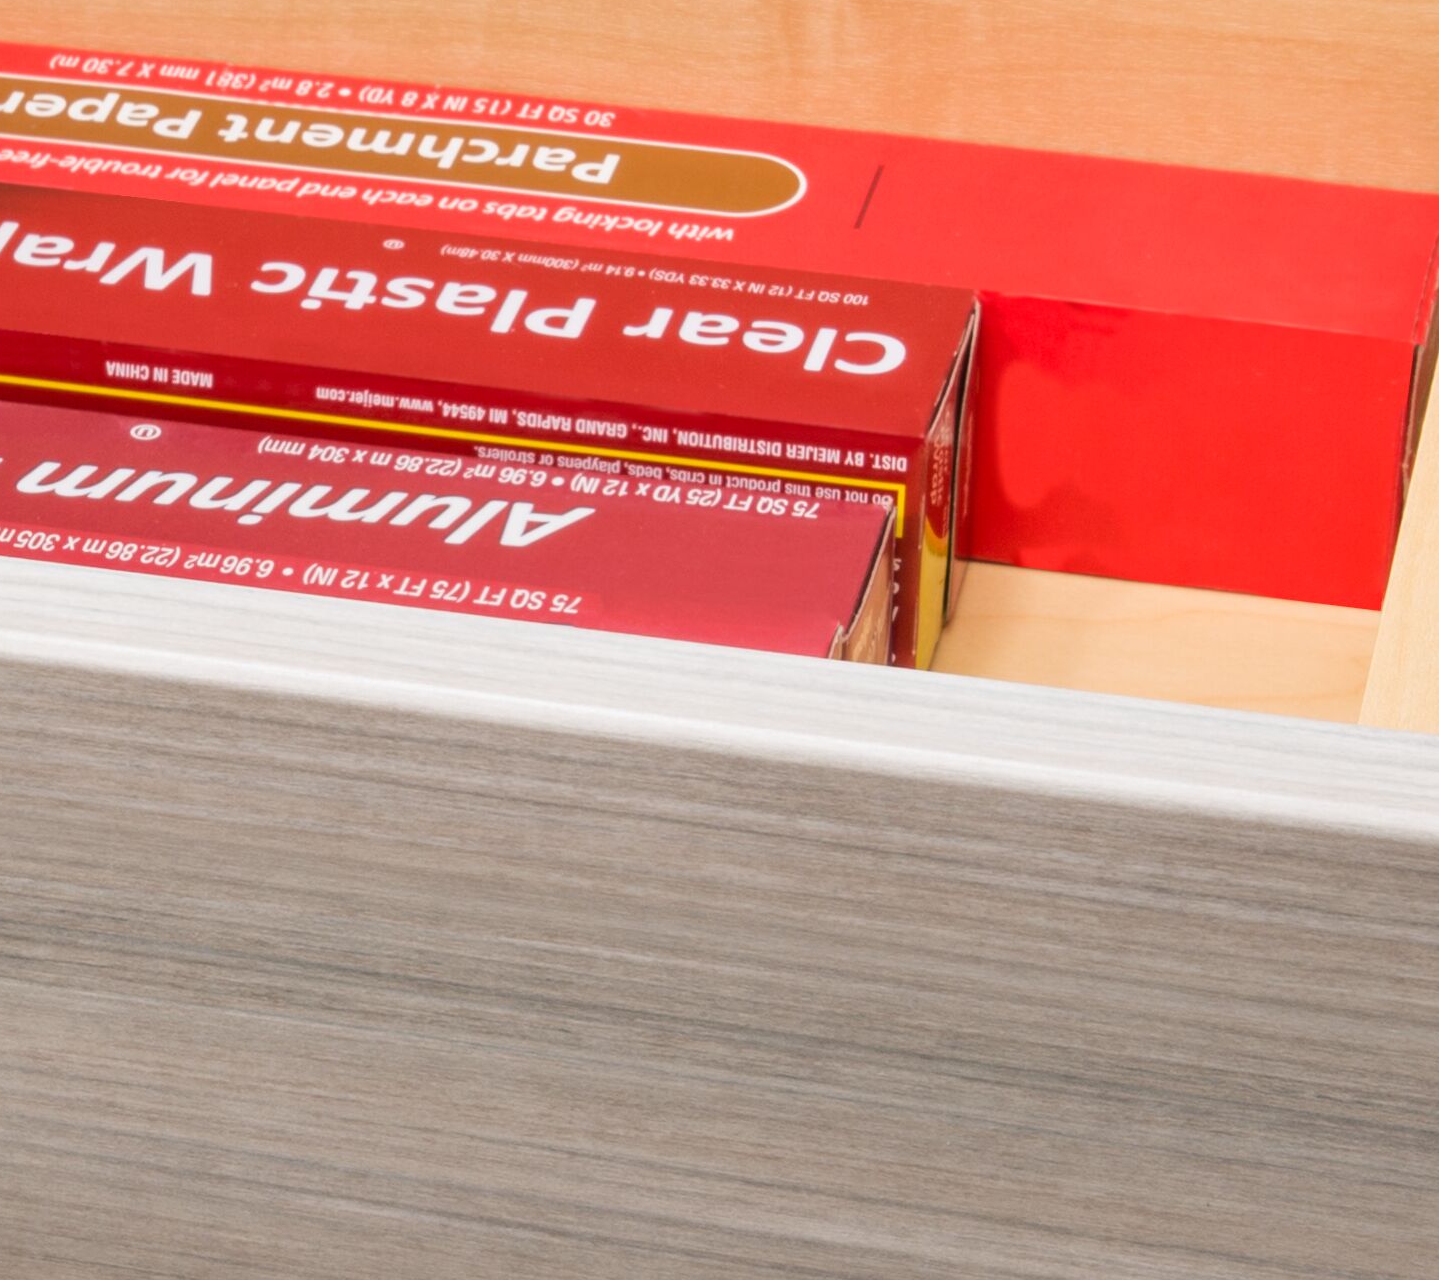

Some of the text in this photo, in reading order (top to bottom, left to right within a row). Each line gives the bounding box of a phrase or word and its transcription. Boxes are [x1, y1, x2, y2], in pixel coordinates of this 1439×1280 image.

[217, 113, 620, 183] Parchment
[4, 148, 180, 179] trouble-free
[180, 168, 227, 187] for
[226, 173, 314, 197] panel
[314, 182, 377, 205] end
[376, 189, 451, 209] each
[450, 197, 495, 214] on
[494, 201, 561, 222] tabs
[560, 206, 670, 236] locking
[669, 222, 733, 241] with
[250, 261, 596, 338] Plastic
[622, 306, 906, 374] Clear
[105, 360, 212, 387] MADE IN CHINA
[315, 386, 433, 412] www.meijer.com
[437, 400, 485, 420] 49544,
[488, 408, 507, 424] MI
[512, 409, 571, 431] RAPIDS,
[574, 418, 627, 438] GRAND
[672, 428, 781, 457] DISTRIBUTION,
[785, 443, 840, 463] MEIJER
[844, 450, 864, 467] BY
[869, 453, 907, 471] DIST.
[16, 461, 595, 545] Aluminum
